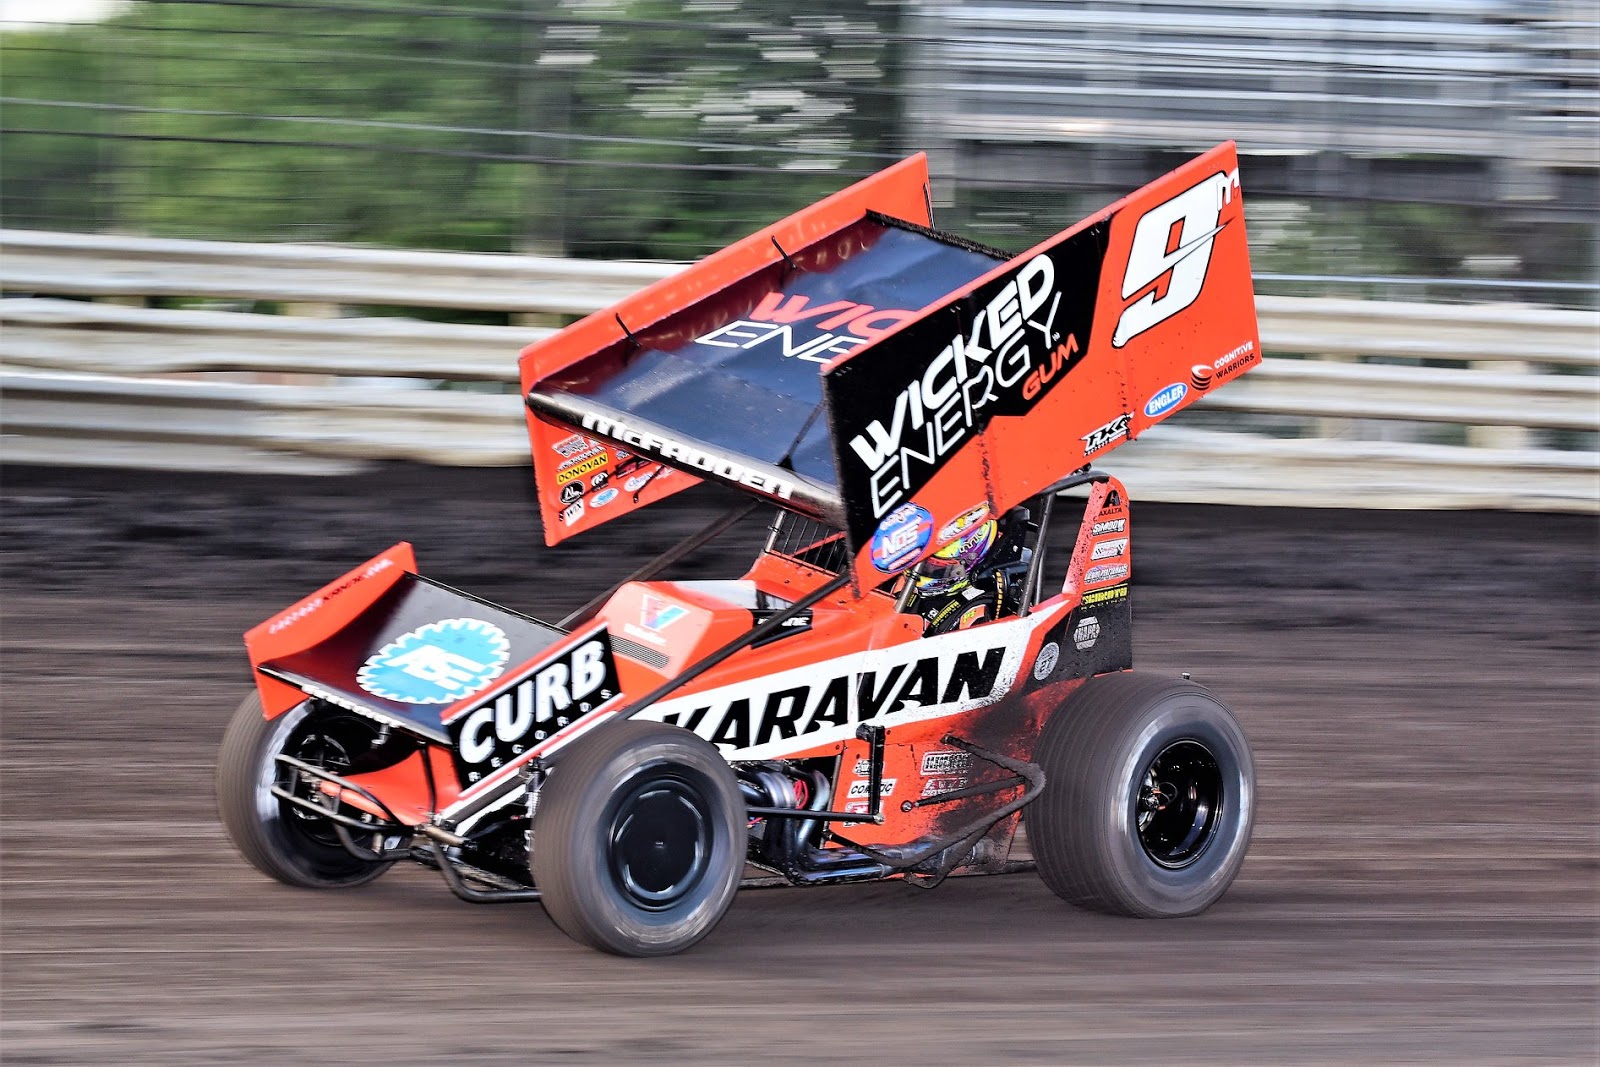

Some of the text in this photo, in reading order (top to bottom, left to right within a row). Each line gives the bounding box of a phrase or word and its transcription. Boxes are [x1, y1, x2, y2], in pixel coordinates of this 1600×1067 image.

[849, 253, 1055, 471] WICKED
[1022, 333, 1079, 401] GUM
[1213, 340, 1253, 369] COGNITIVE
[1215, 353, 1255, 379] WARRIORS
[870, 291, 1062, 519] ENERGY
[1148, 384, 1185, 416] ENGLER
[557, 454, 608, 484] DONOVAN
[566, 502, 582, 518] WIX
[1098, 507, 1123, 517] AXALTA
[881, 515, 923, 560] NOS
[459, 640, 607, 764] CURB
[468, 688, 613, 783] RECORDS
